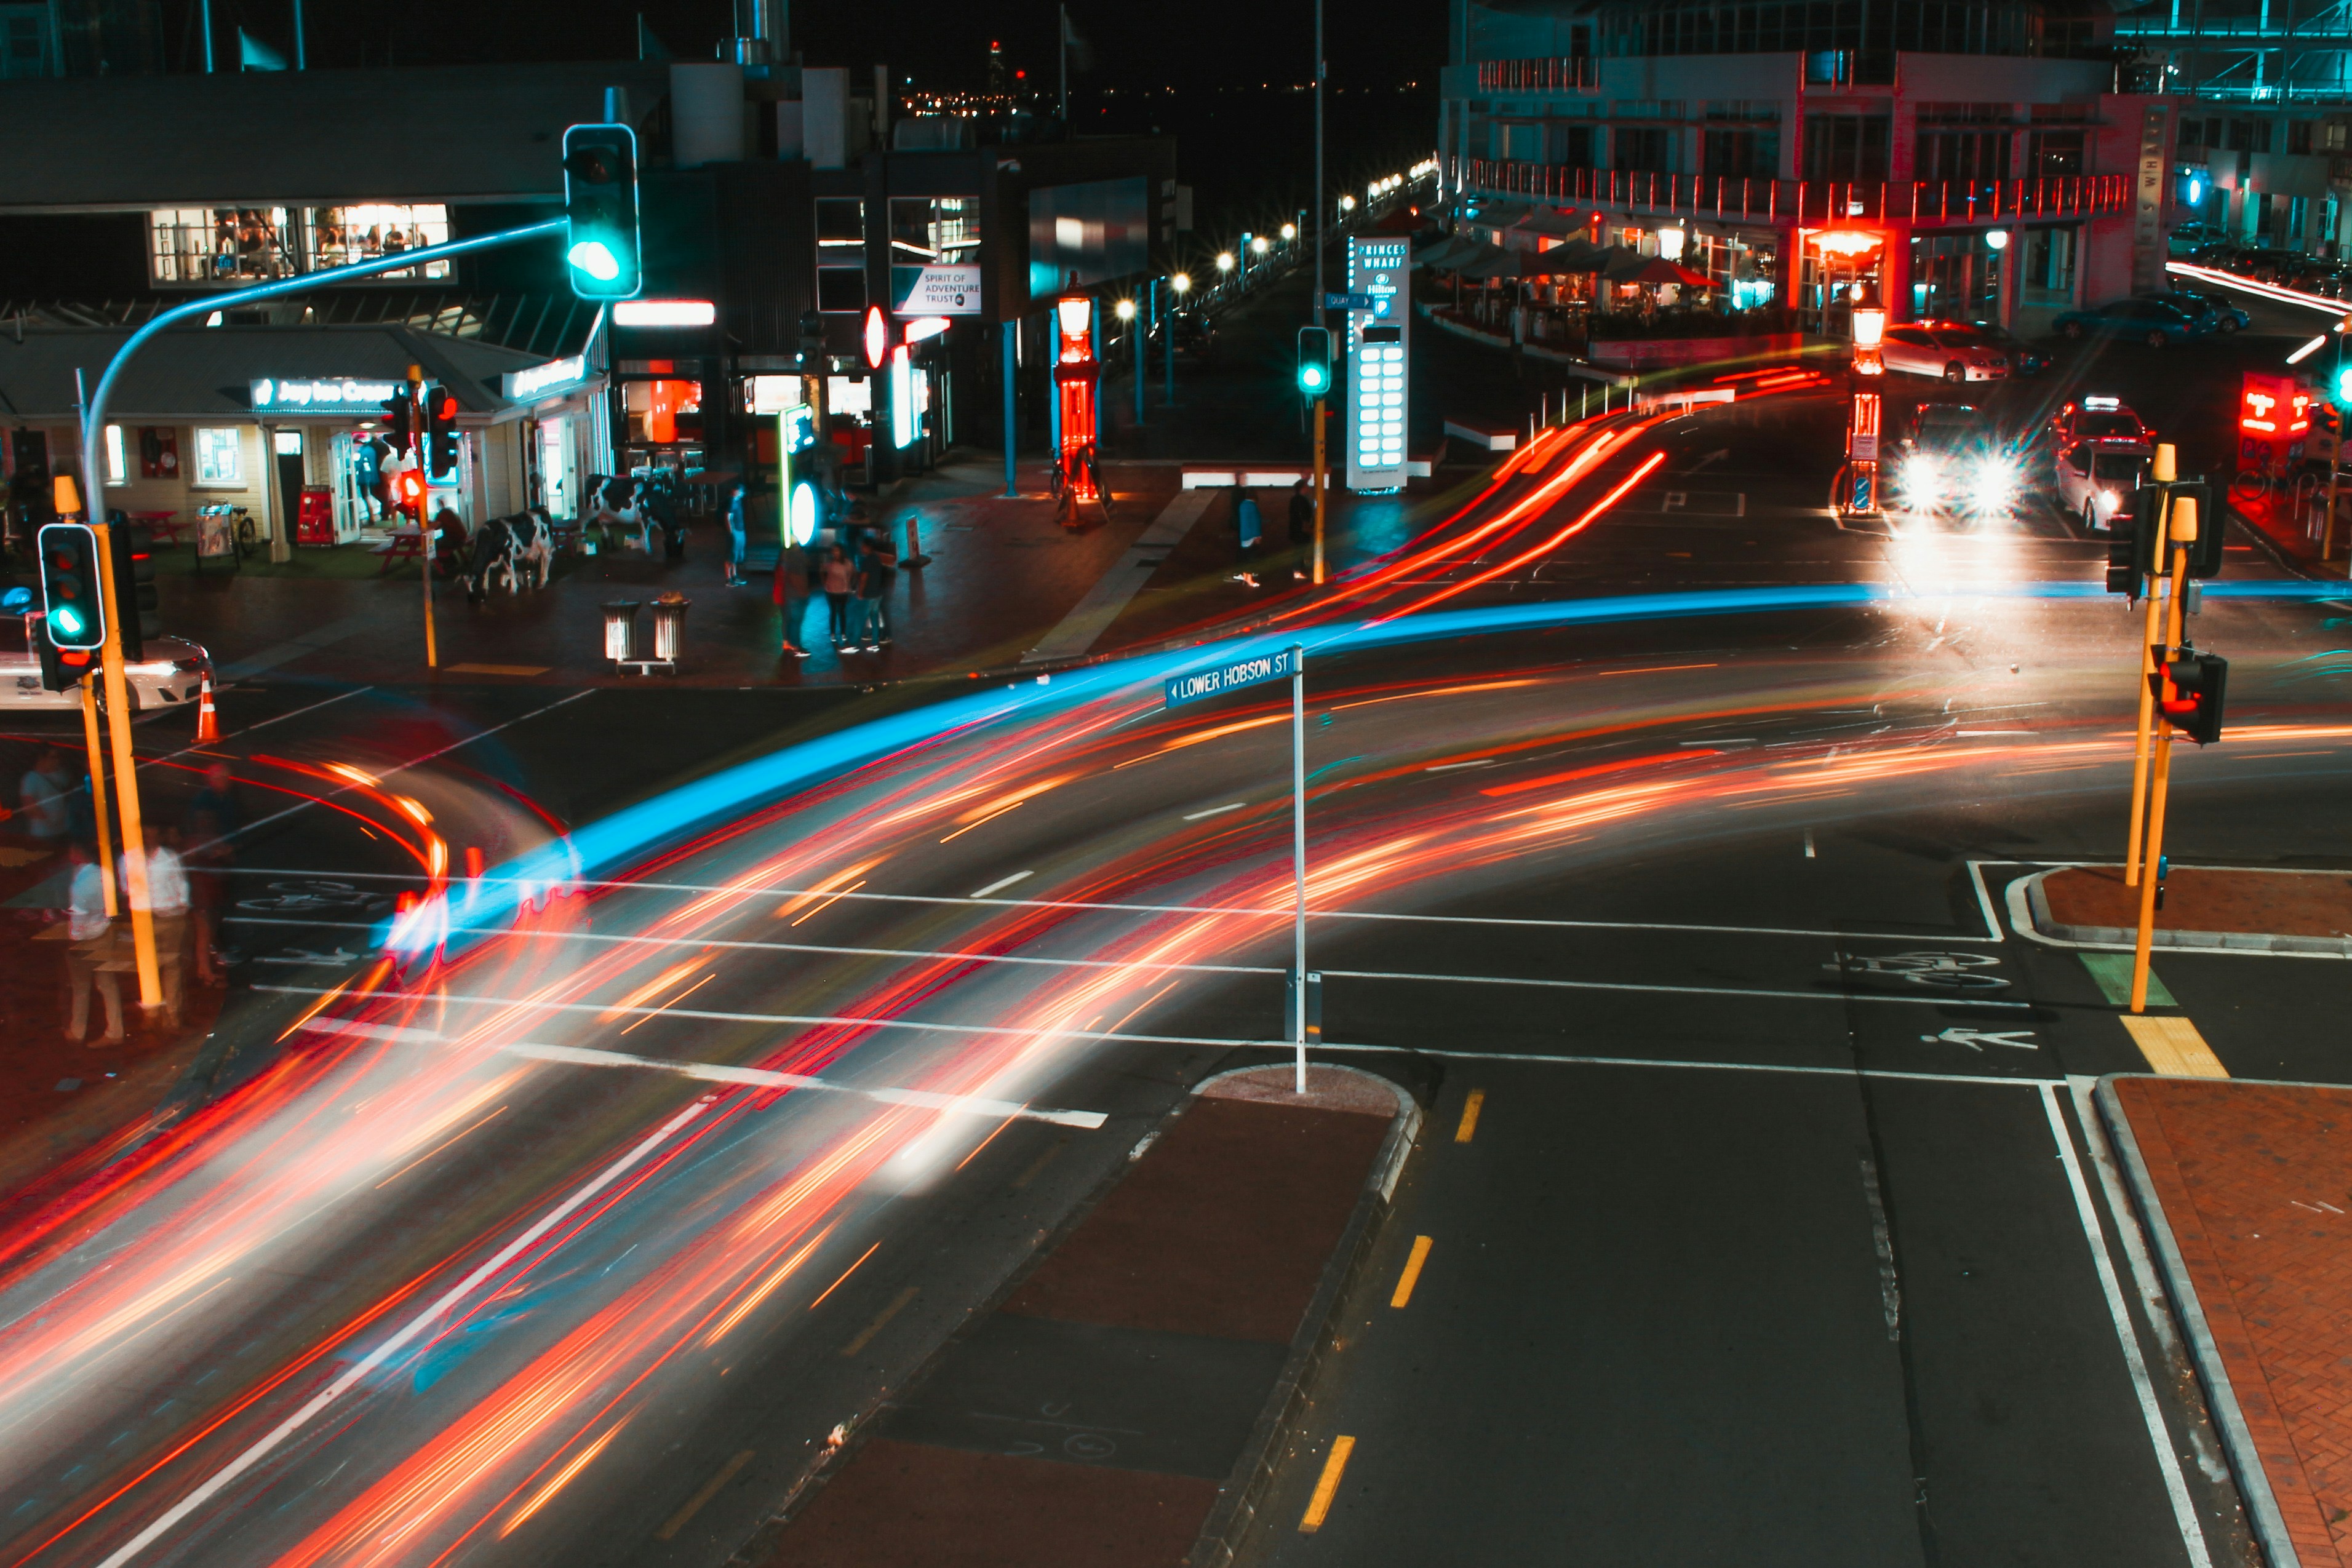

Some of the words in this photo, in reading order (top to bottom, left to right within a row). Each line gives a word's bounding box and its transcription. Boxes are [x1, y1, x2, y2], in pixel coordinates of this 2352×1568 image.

[2144, 113, 2160, 187] WHA
[1358, 245, 1406, 255] PRINCES
[1363, 257, 1402, 269] WHARF
[1367, 284, 1397, 295] Hilton
[1331, 296, 1349, 305] QUAY
[1180, 672, 1220, 699] LOWER
[1224, 658, 1271, 686] HOBSON
[1275, 653, 1288, 673] ST
